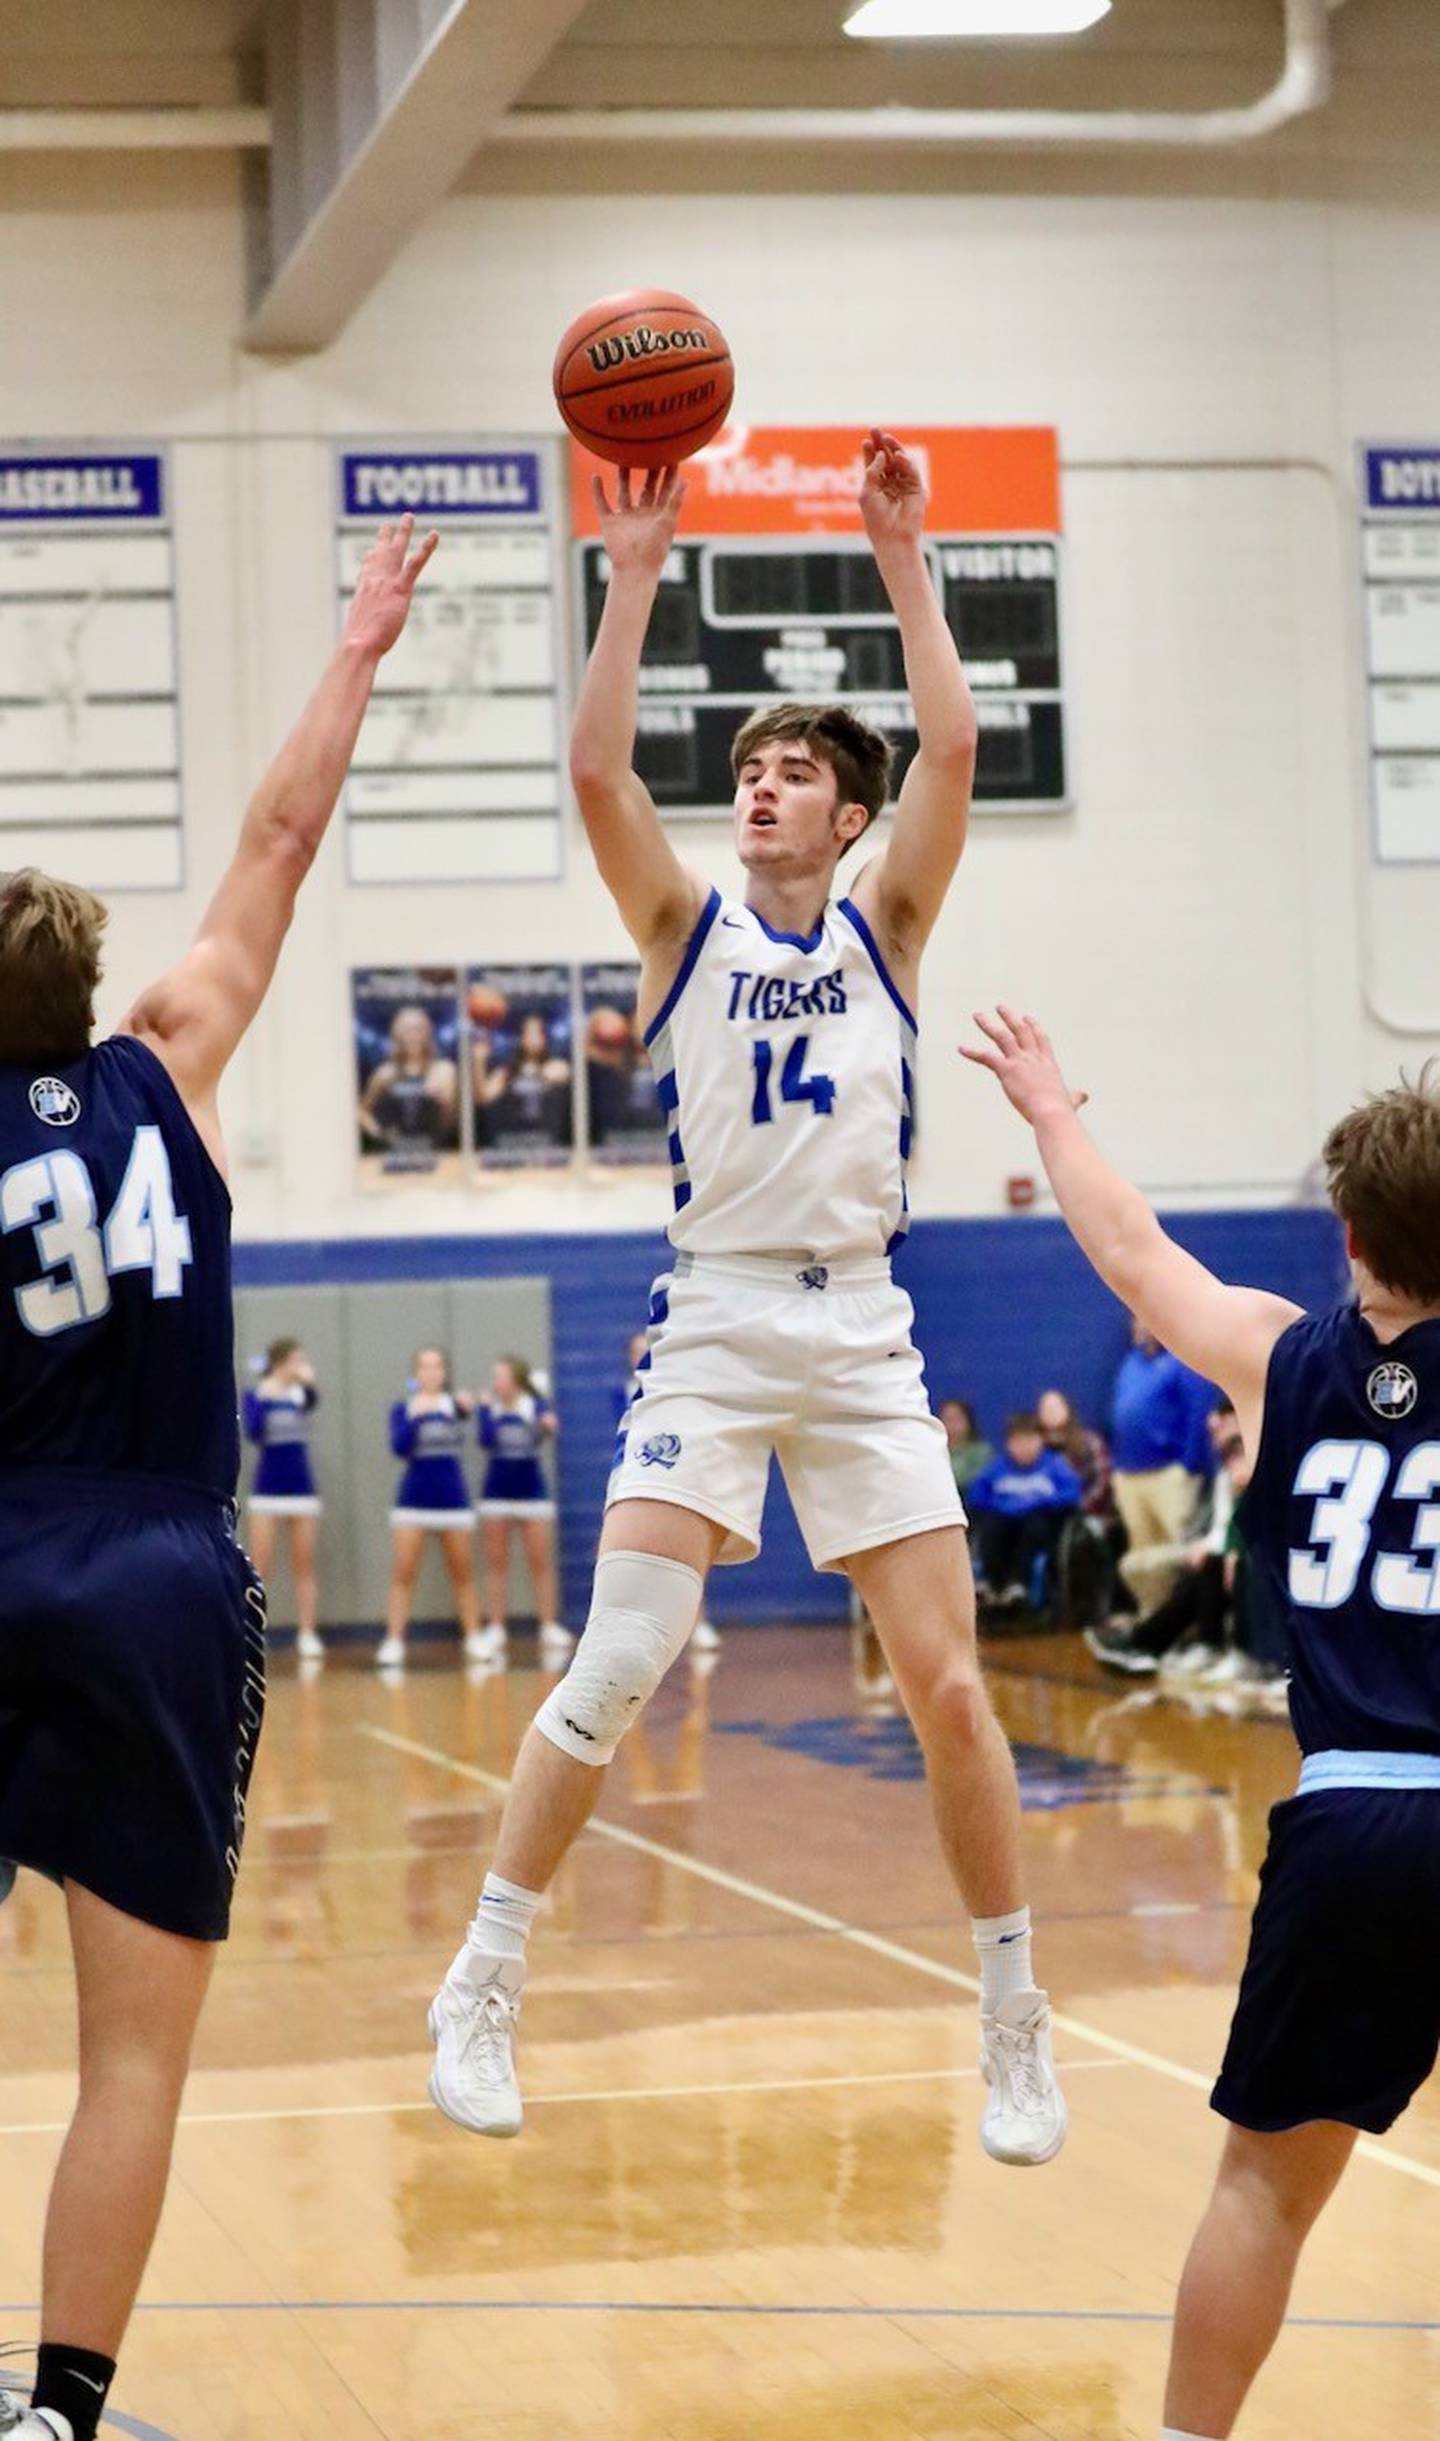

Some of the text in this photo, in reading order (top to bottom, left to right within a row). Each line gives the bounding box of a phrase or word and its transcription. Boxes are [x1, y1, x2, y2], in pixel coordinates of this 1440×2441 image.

[585, 324, 709, 372] Wilson
[606, 379, 716, 424] EVOLUTION
[355, 463, 529, 505] FOOTBALL
[942, 546, 1056, 580] VISITOR
[726, 967, 849, 1021] TIGERS
[750, 1034, 836, 1127] 14
[0, 1124, 194, 1339] 34
[1287, 1437, 1440, 1616] 33
